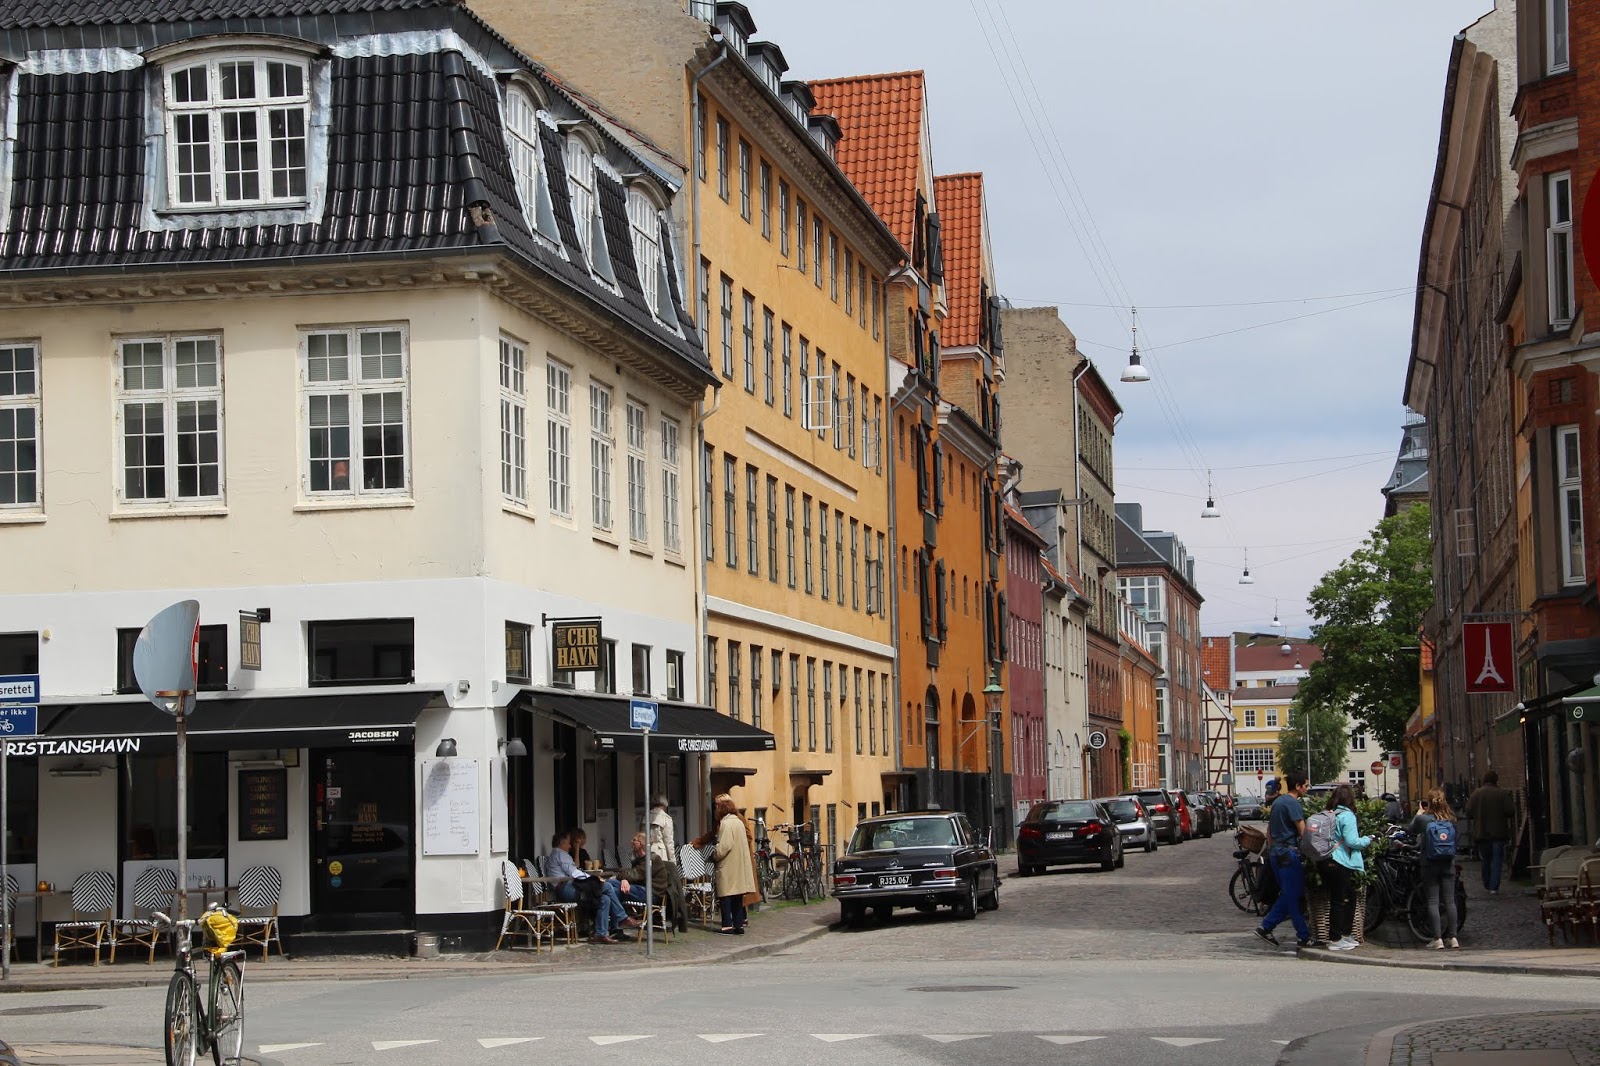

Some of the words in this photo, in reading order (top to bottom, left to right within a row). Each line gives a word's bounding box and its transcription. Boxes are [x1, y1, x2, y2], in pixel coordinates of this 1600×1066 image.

[567, 627, 599, 646] CHR
[557, 646, 599, 667] HAVN
[348, 730, 400, 739] JACOBSEN
[5, 738, 141, 756] RISTIANSHAVN
